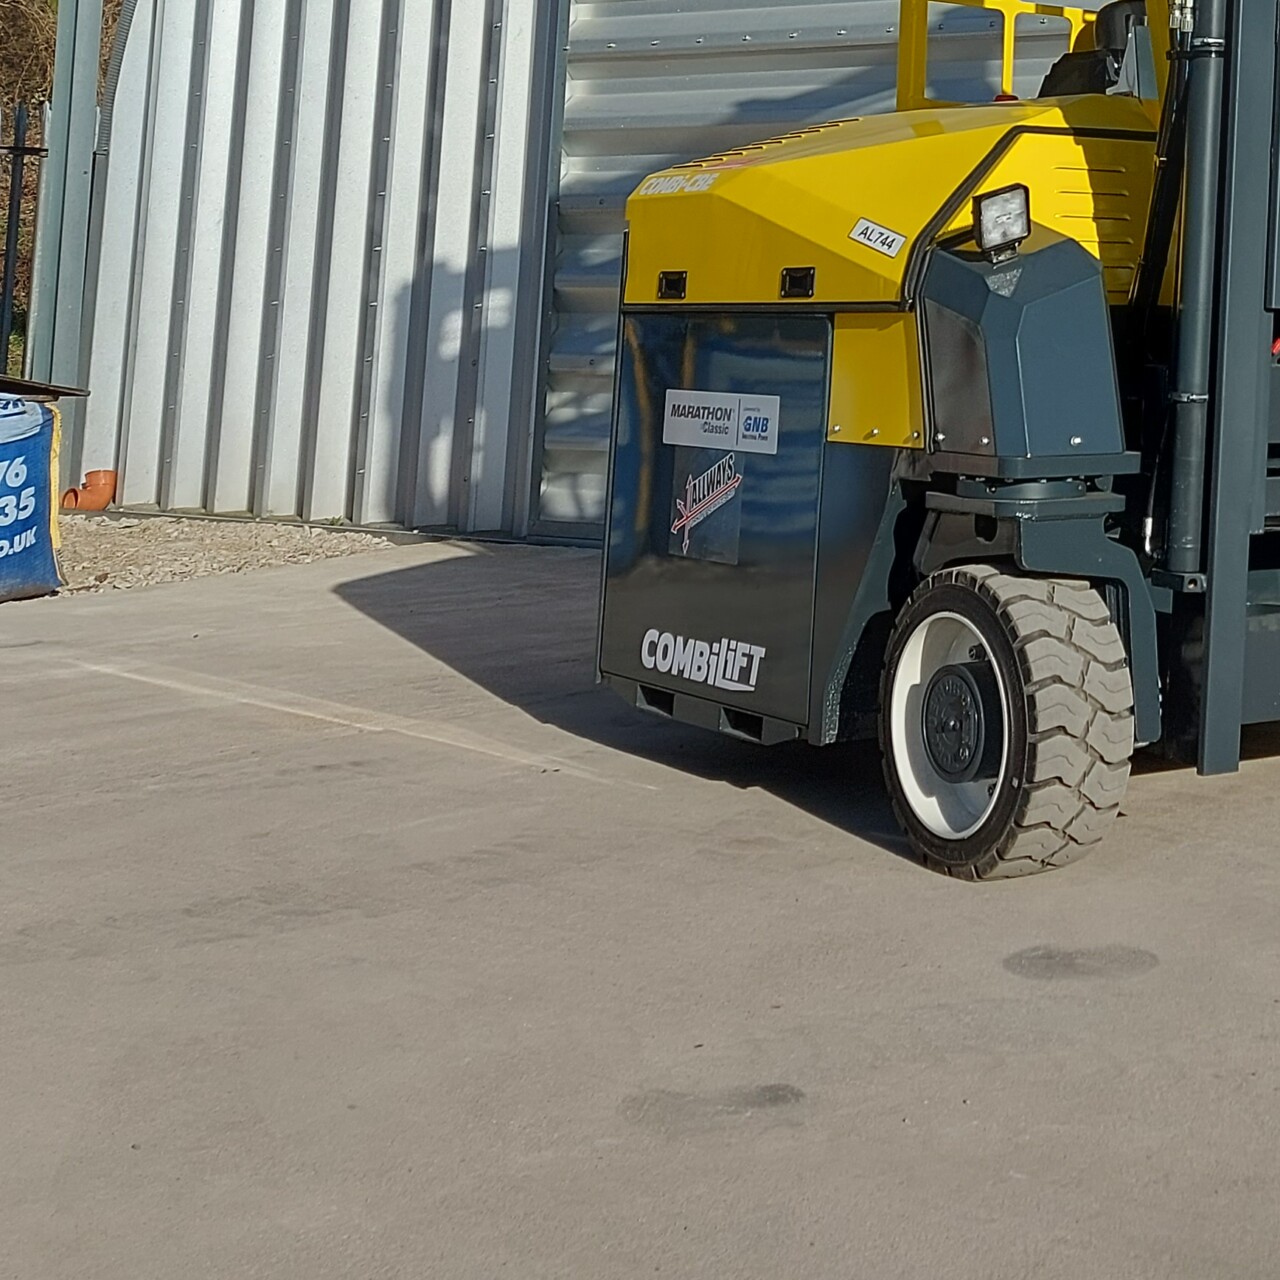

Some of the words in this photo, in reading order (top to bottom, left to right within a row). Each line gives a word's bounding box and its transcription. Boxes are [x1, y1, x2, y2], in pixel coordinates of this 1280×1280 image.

[857, 225, 896, 250] AL744
[670, 403, 733, 422] MARATHON
[702, 421, 729, 435] Classic
[743, 415, 769, 433] GNB
[691, 452, 735, 510] ALLWAYS
[0, 486, 35, 527] 35
